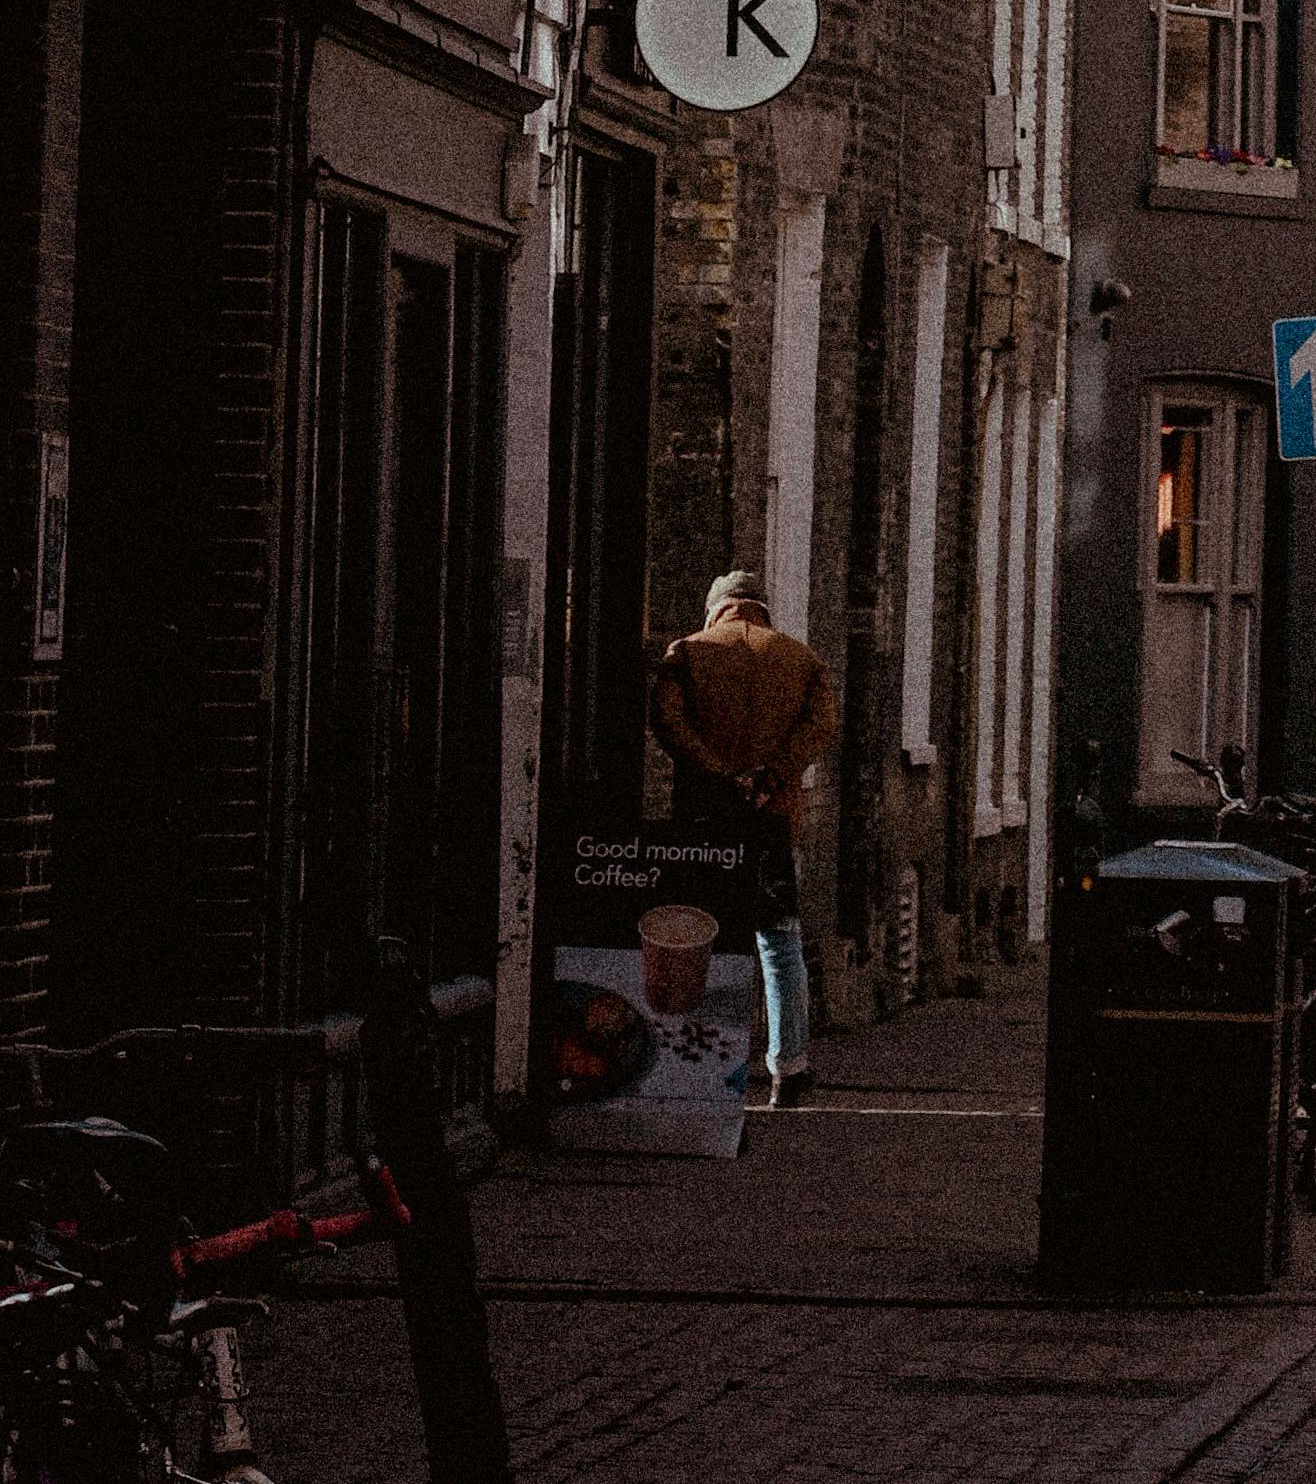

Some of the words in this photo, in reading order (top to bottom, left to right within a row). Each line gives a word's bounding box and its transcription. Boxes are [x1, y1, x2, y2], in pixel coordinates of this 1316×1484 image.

[575, 835, 640, 860] Good
[645, 840, 745, 871] morning!
[573, 862, 663, 890] Coffee?
